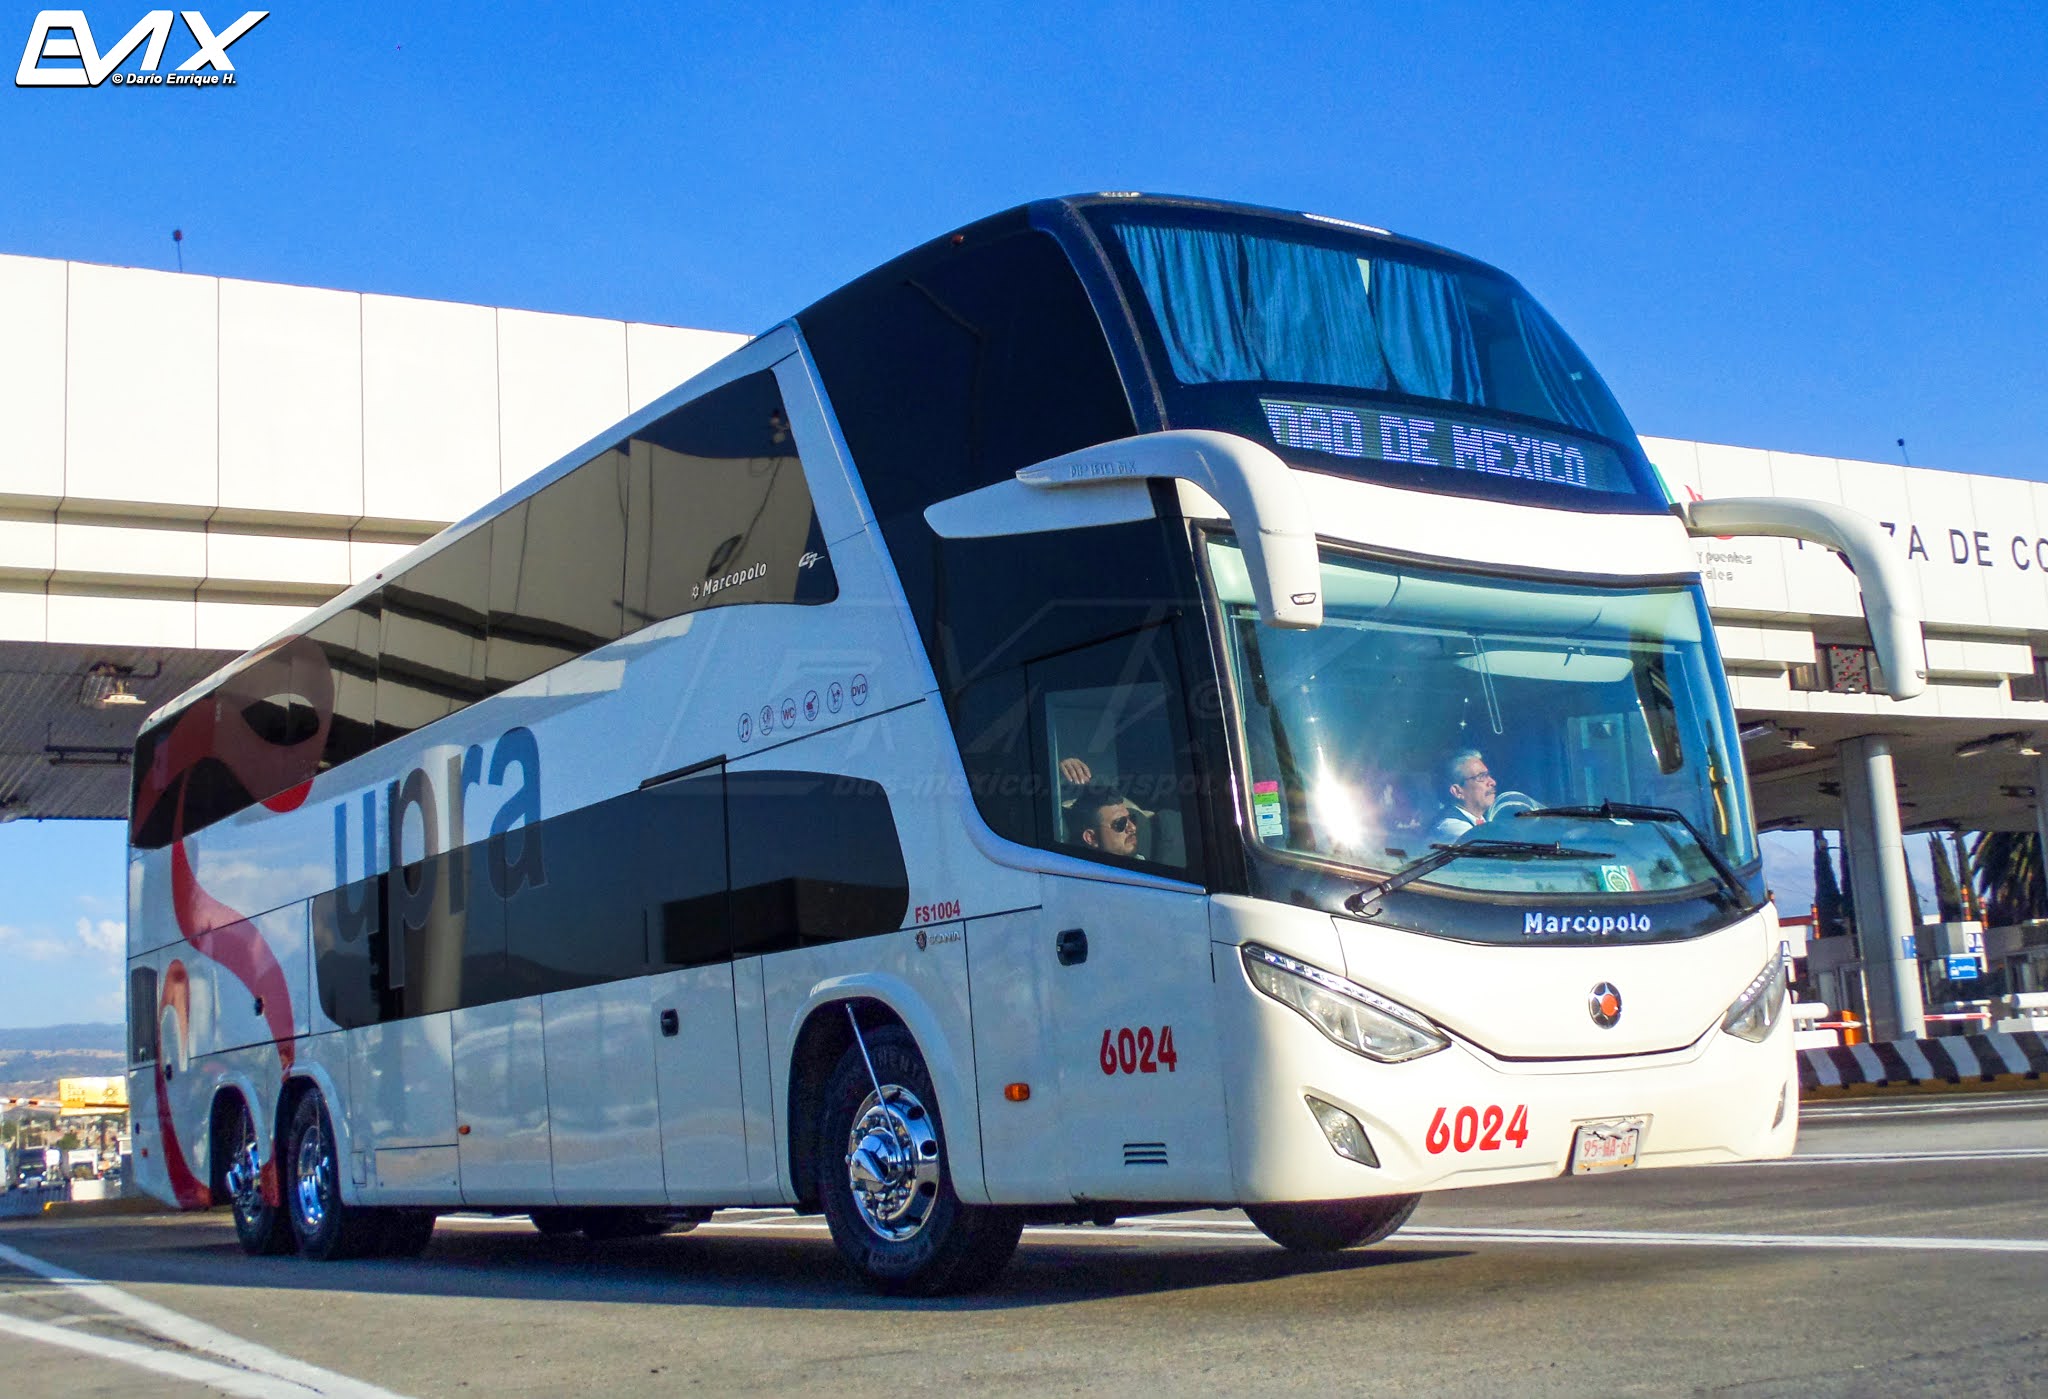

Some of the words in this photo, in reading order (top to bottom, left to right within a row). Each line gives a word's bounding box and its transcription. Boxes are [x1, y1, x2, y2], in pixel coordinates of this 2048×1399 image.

[1379, 415, 1438, 465] DE
[1452, 425, 1586, 486] MEXICO
[1949, 528, 1993, 567] DE
[703, 562, 766, 597] Marcopolo
[851, 684, 866, 697] DVD
[783, 707, 795, 720] WC
[915, 899, 960, 923] FS1004
[1523, 912, 1651, 935] Marcopolo
[1100, 1025, 1177, 1075] 6024
[1426, 1104, 1529, 1154] 6024
